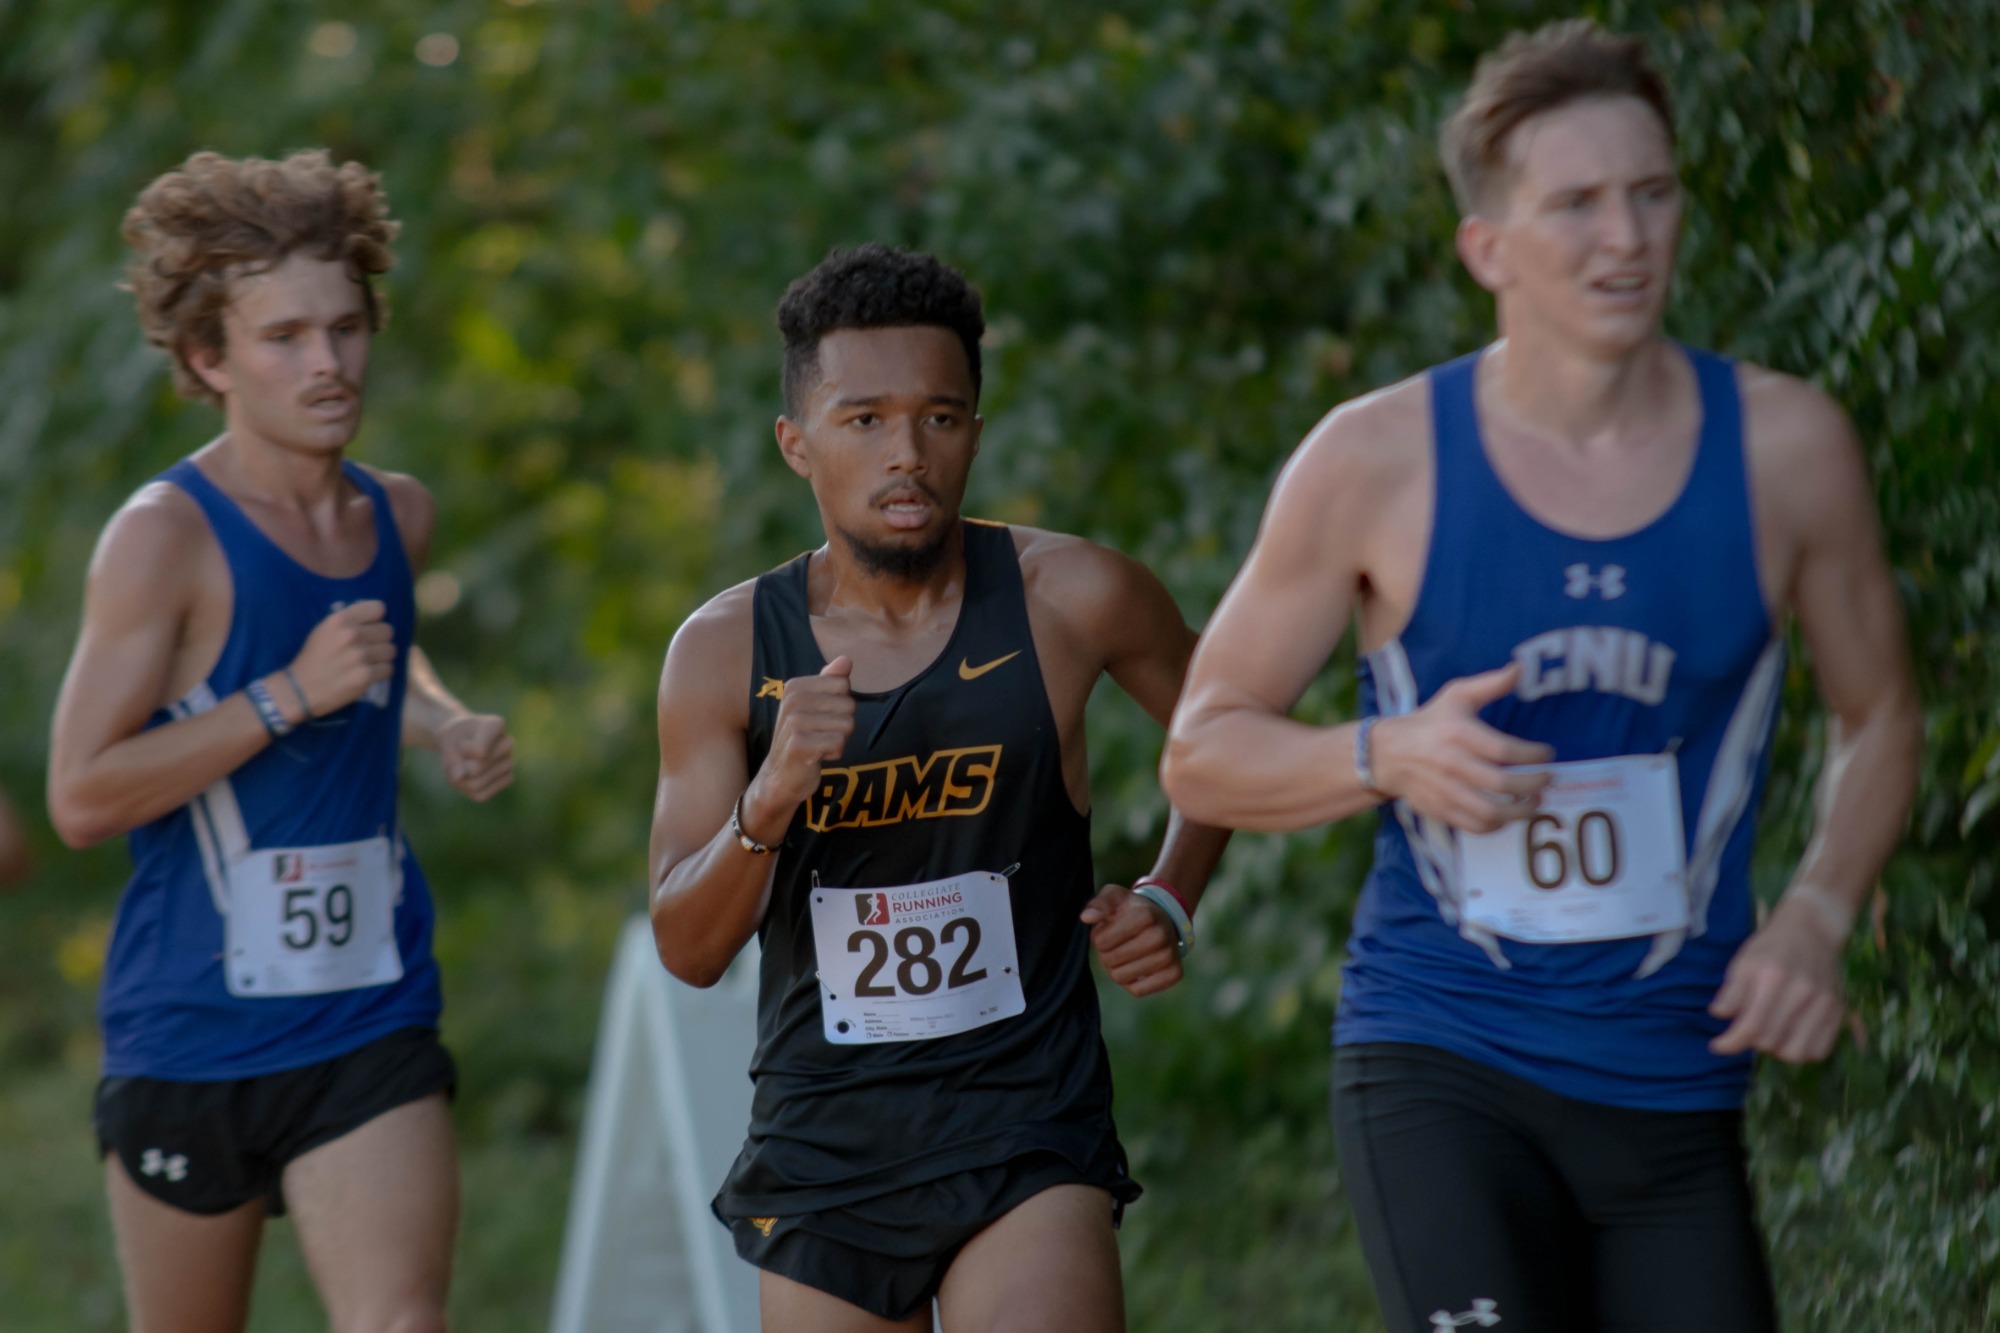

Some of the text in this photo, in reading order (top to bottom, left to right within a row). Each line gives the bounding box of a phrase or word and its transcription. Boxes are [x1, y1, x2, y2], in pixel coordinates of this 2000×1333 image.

[1512, 626, 1677, 706] CNU
[806, 744, 1003, 832] RAMS
[1526, 811, 1618, 890] 60
[282, 884, 354, 951] 59
[891, 883, 960, 901] COLLEGIATE
[892, 892, 962, 913] RUNNING
[895, 907, 965, 924] ASSOCIATION
[847, 917, 988, 998] 282
